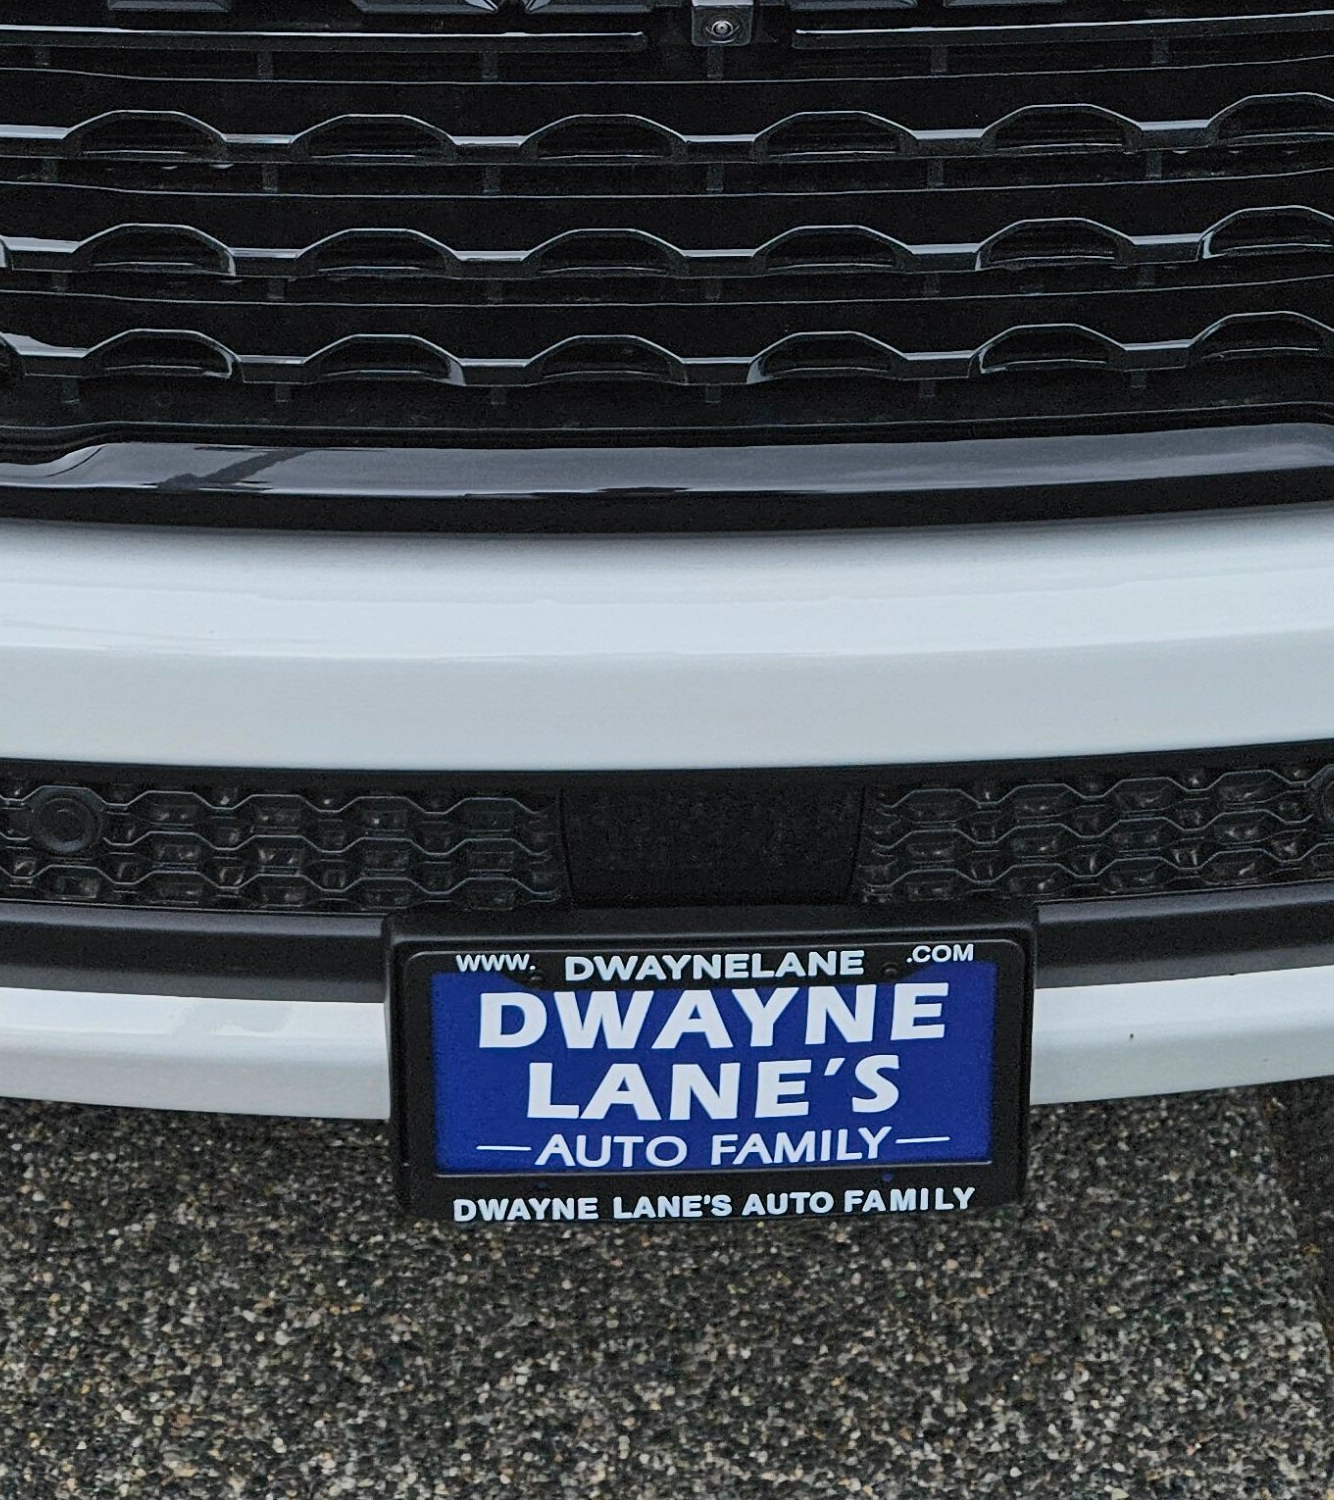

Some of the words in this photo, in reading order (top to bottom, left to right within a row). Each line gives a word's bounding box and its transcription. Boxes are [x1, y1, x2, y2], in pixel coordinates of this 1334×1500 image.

[565, 949, 865, 983] DWAYNELANE
[906, 943, 975, 964] .COM
[479, 982, 949, 1049] DWAYNE
[527, 1054, 900, 1121] LANE'S
[534, 1134, 688, 1168] AUTO
[711, 1126, 893, 1166] FAMILY
[453, 1197, 599, 1222] DWAYNE
[613, 1193, 733, 1219] LANE'S
[741, 1190, 835, 1216] AUTO
[844, 1187, 976, 1213] FAMILY
